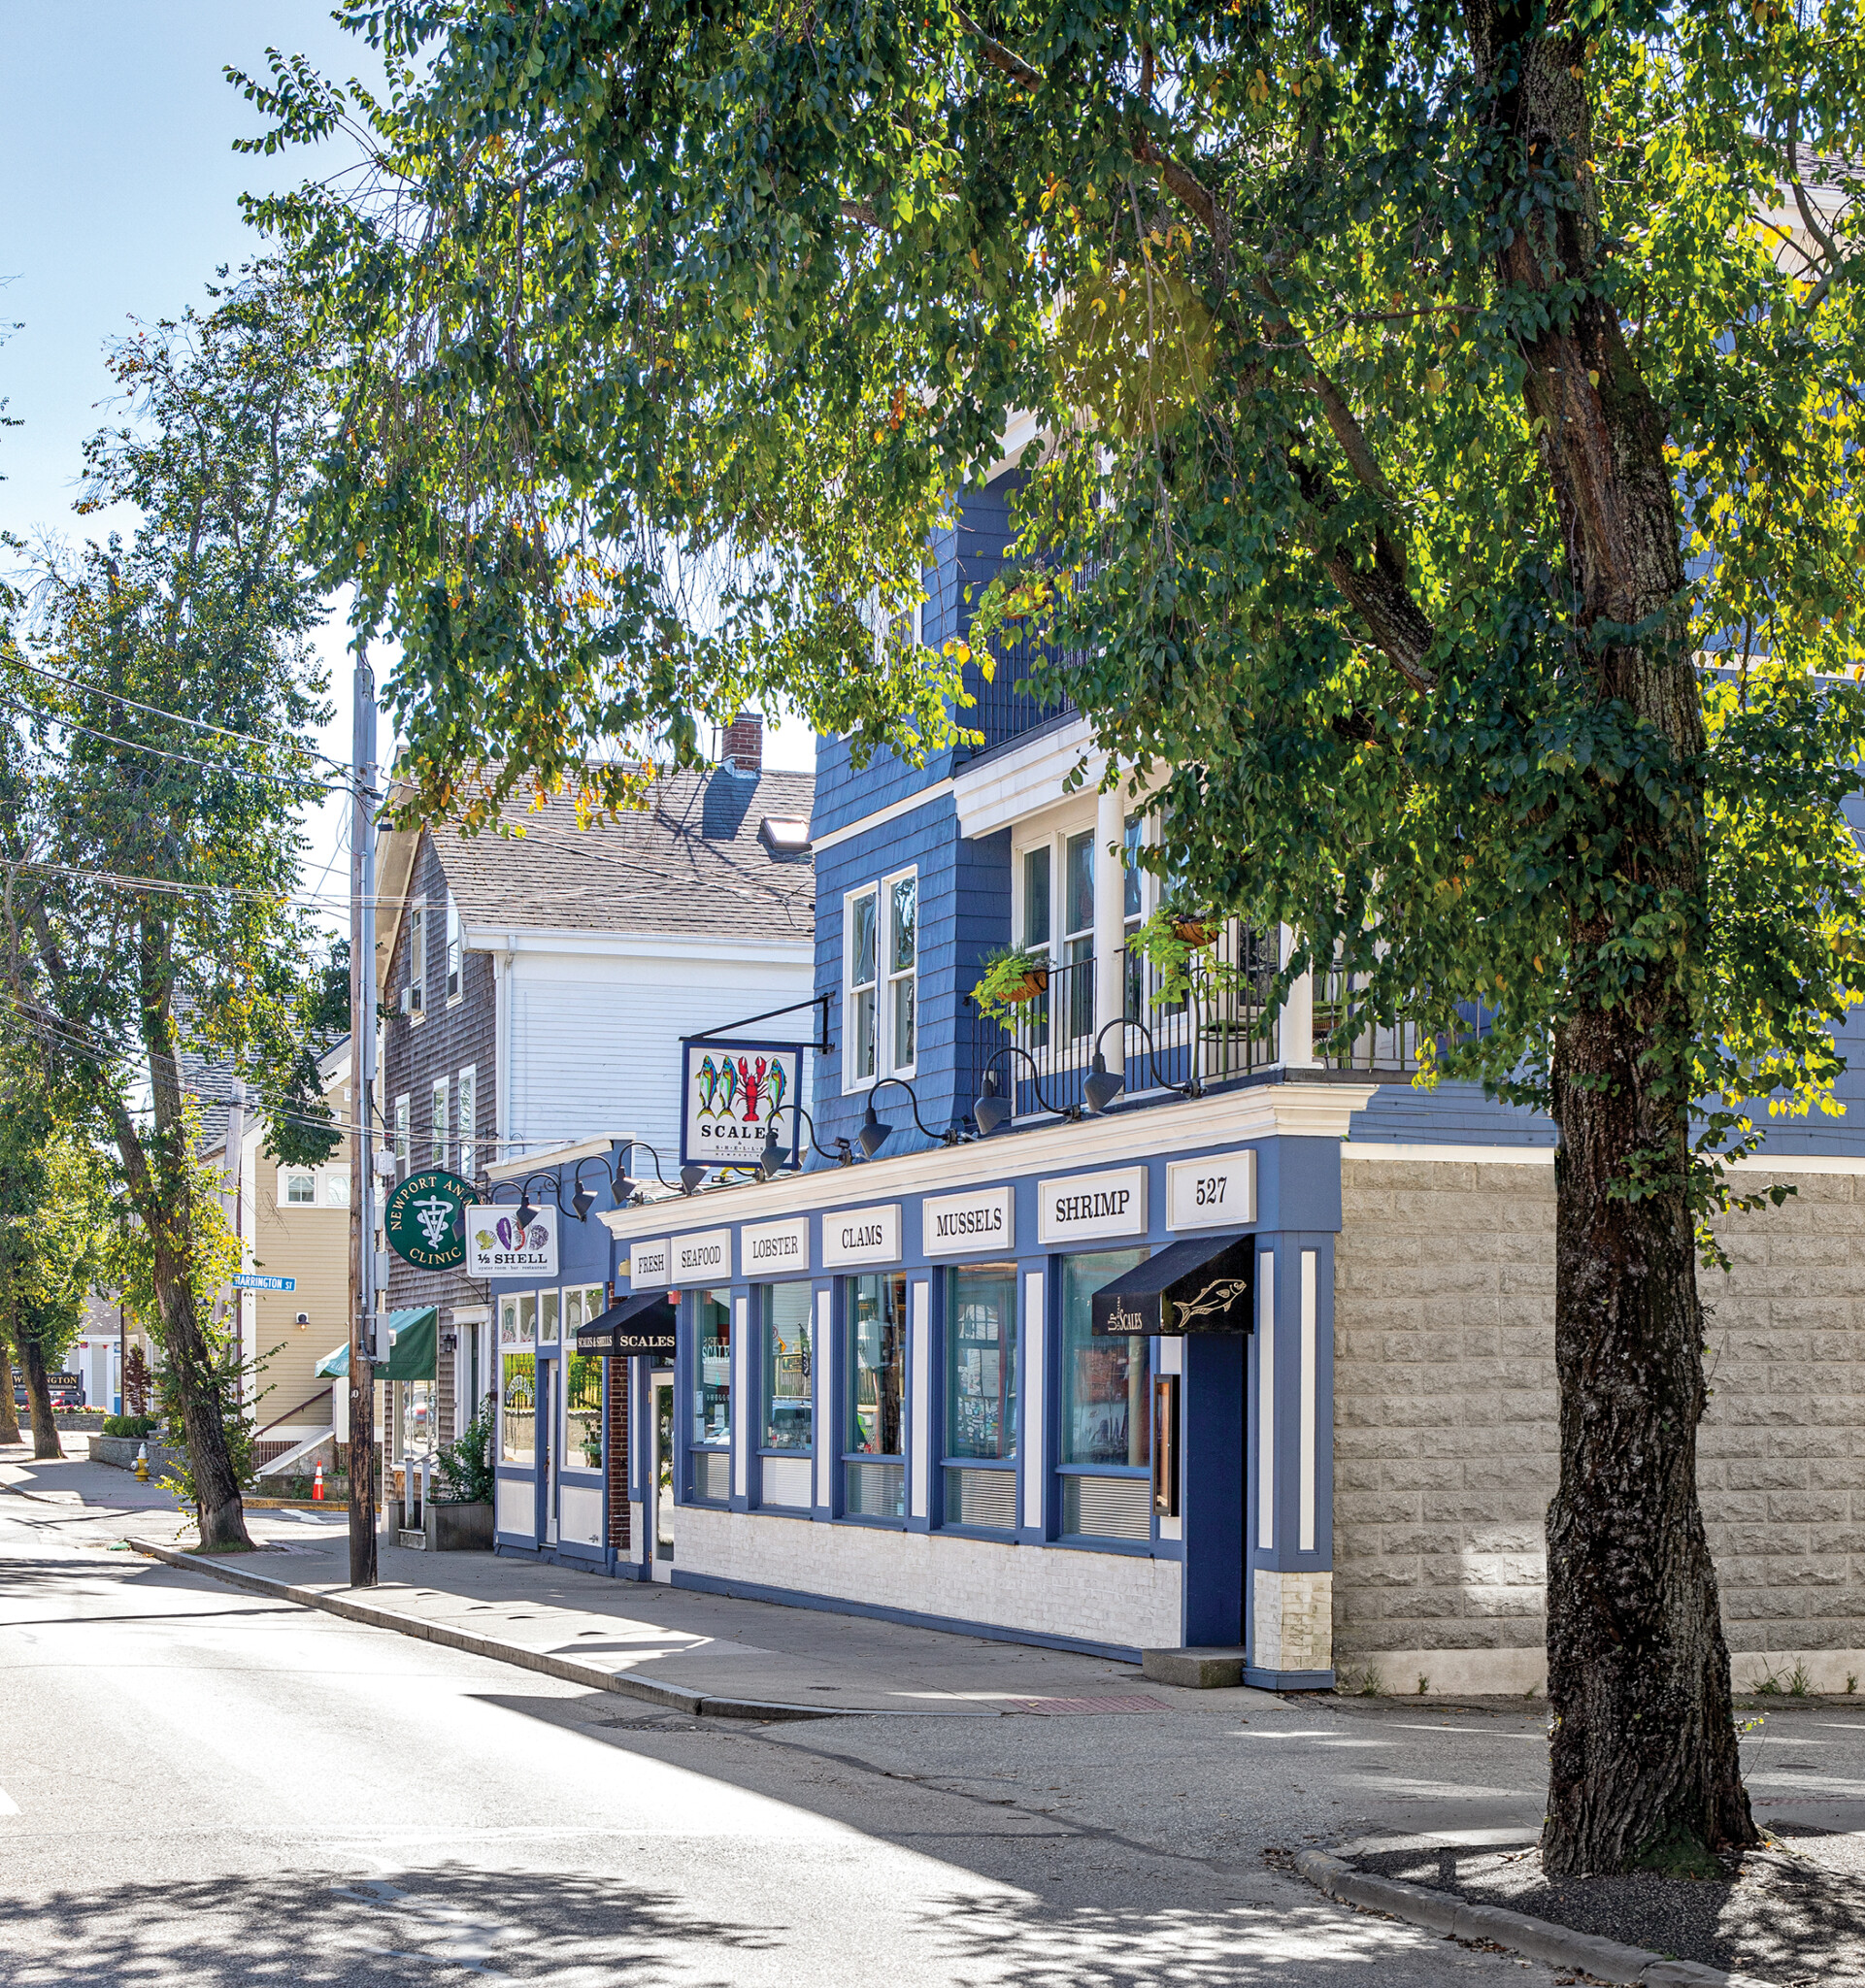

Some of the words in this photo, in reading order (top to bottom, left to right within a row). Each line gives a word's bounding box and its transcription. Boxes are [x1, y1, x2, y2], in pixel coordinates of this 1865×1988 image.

[701, 1125, 779, 1140] SCALES
[1196, 1176, 1227, 1206] 527
[390, 1176, 437, 1232] NEWPORT
[1055, 1189, 1130, 1223] SHRIMP
[936, 1208, 1002, 1237] MUSSELS
[752, 1235, 799, 1259] LOBSTER
[841, 1224, 883, 1249] CLAMS
[409, 1246, 462, 1265] CLINIC
[494, 1253, 548, 1264] SHELL
[638, 1253, 665, 1275] FRESH
[681, 1245, 721, 1269] SEAFOOD
[285, 1281, 293, 1290] ST
[1119, 1309, 1143, 1331] SCALES
[619, 1335, 676, 1347] SCALES
